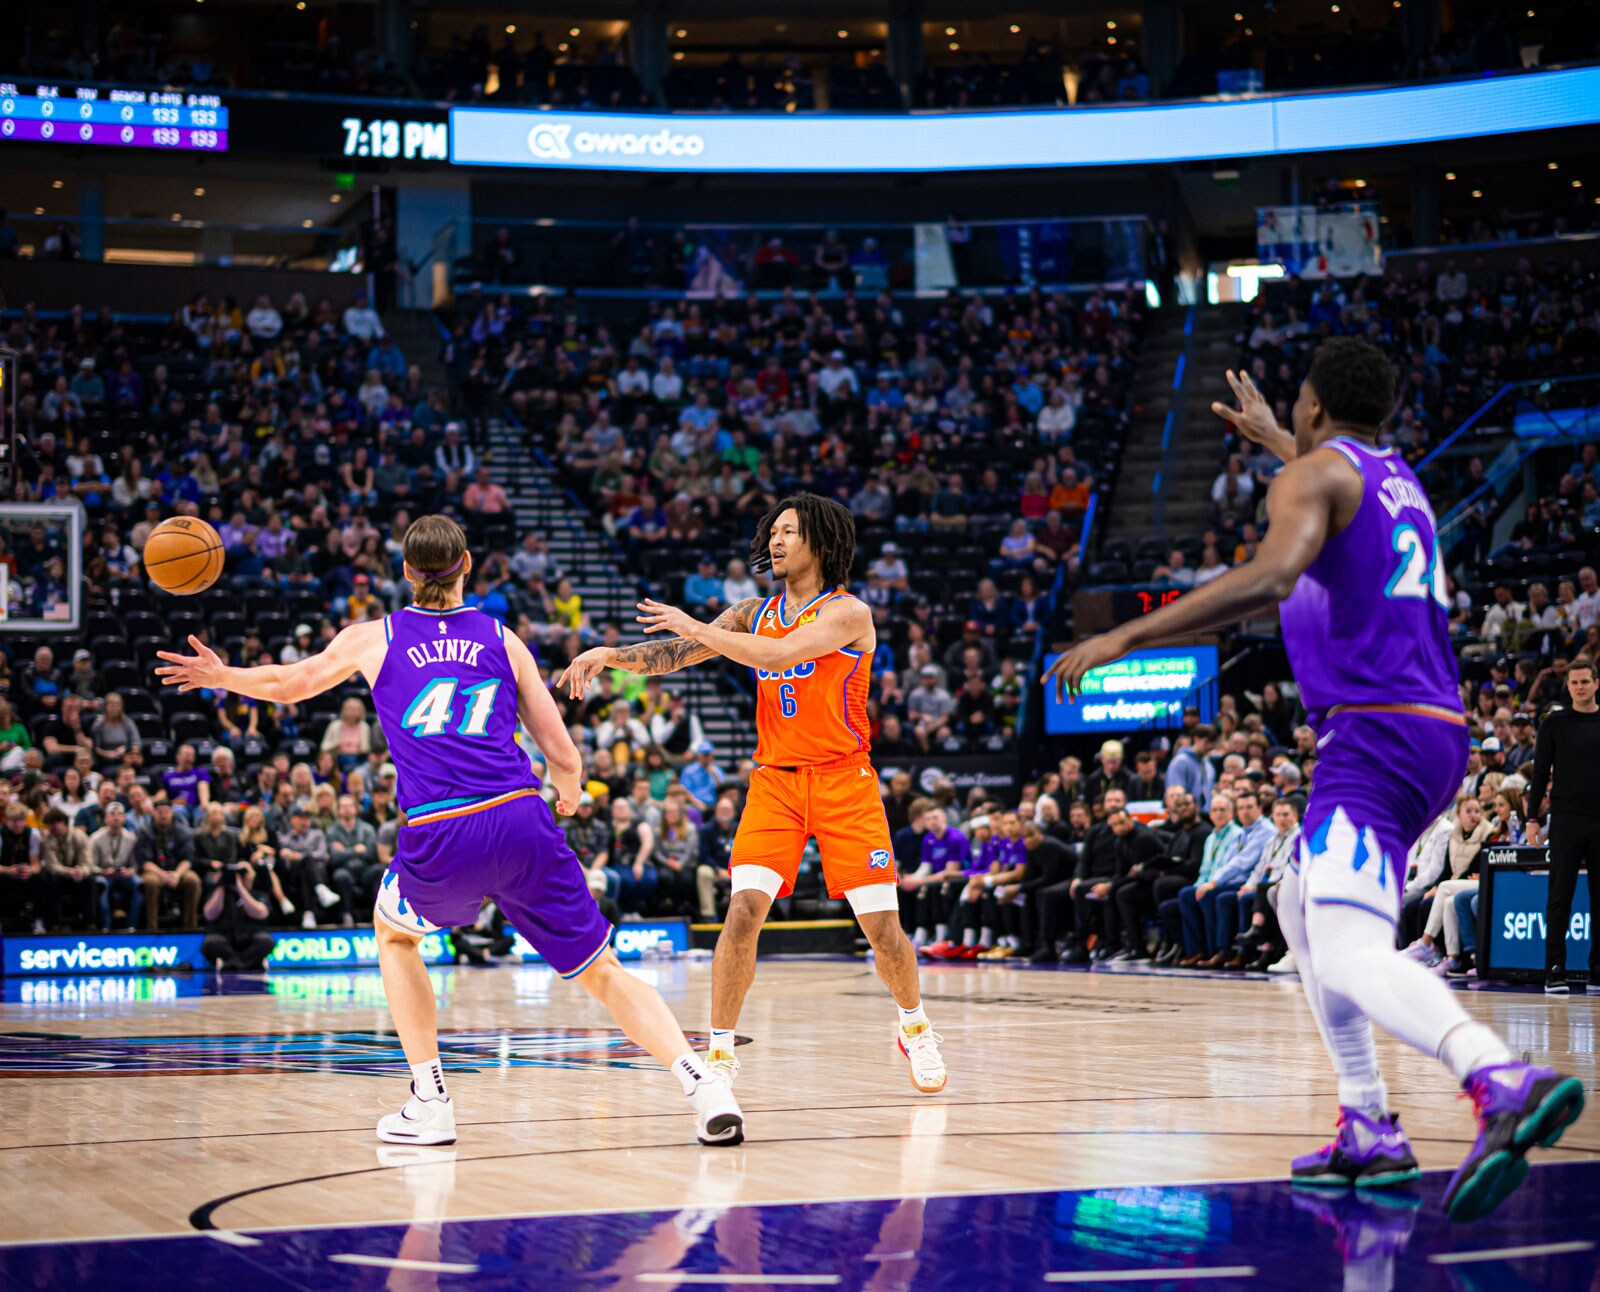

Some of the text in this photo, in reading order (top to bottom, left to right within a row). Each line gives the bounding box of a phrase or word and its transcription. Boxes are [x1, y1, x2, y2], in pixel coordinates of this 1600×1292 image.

[37, 85, 59, 98] BLK
[2, 98, 15, 115] 0
[41, 100, 54, 117] 0
[80, 102, 93, 119] 0
[121, 105, 134, 121] 0
[1, 118, 15, 136] 0
[40, 121, 54, 139] 0
[79, 123, 93, 141] 0
[121, 125, 134, 143] 0
[342, 118, 448, 160] 7:13 PM
[574, 129, 704, 156] awardco
[766, 609, 775, 619] 6
[407, 639, 485, 668] OLYNYK
[401, 677, 501, 737] 41
[779, 683, 797, 718] 6
[1495, 850, 1518, 864] vivint
[20, 941, 178, 970] servicenow
